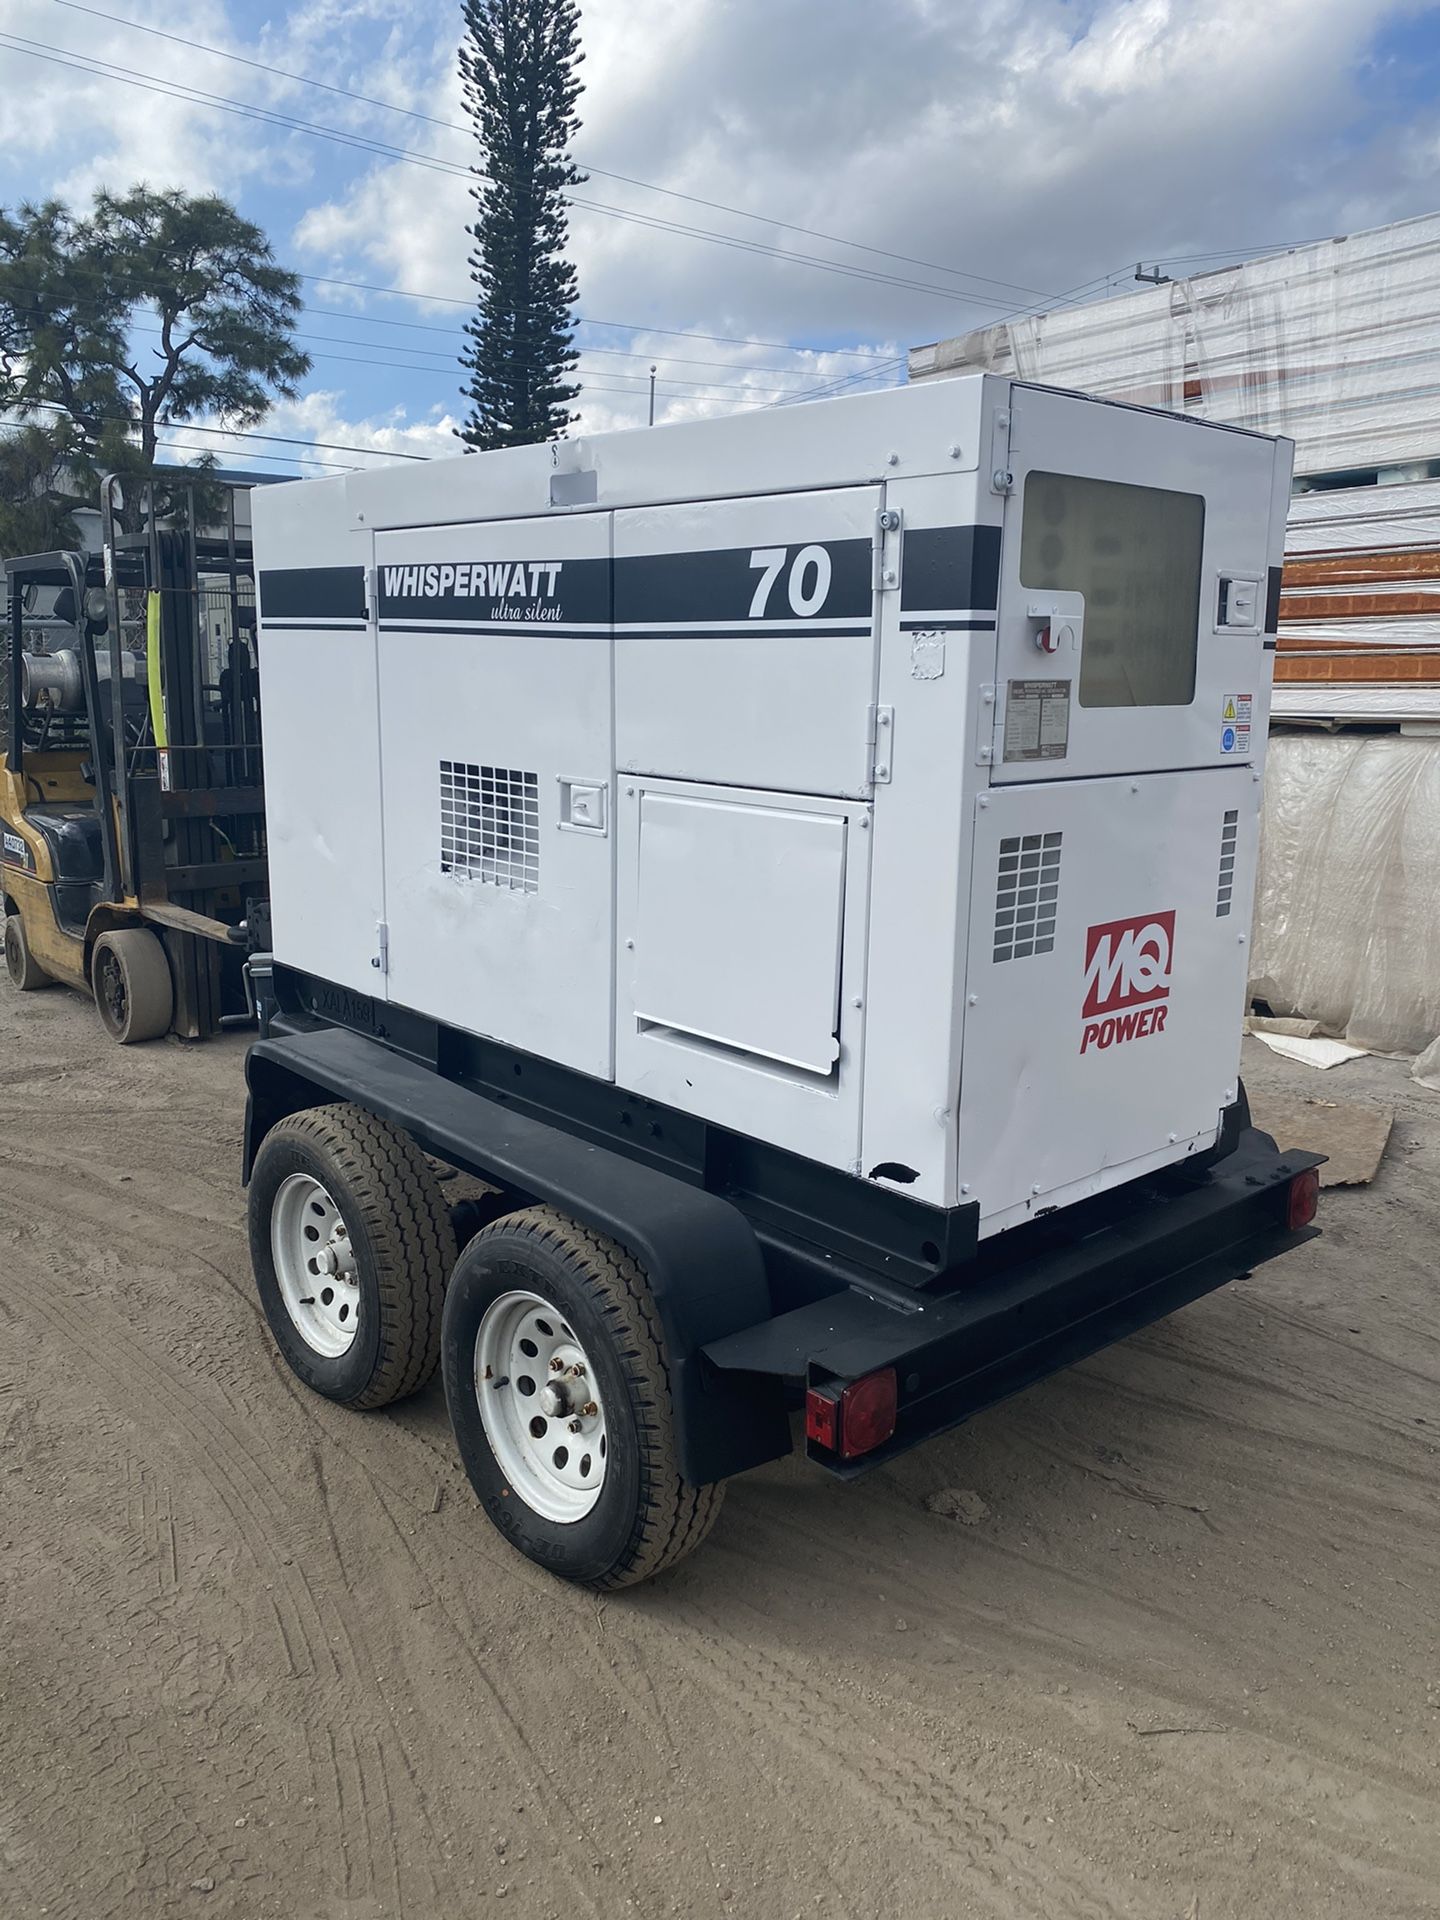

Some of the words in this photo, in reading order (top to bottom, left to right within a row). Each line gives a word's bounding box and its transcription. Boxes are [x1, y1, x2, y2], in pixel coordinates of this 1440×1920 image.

[384, 562, 563, 597] WHISPERWATT
[748, 544, 832, 618] 70
[490, 597, 522, 620] ultra
[525, 597, 563, 621] silent
[1082, 921, 1171, 1004] MQ
[1080, 1004, 1169, 1055] POWER
